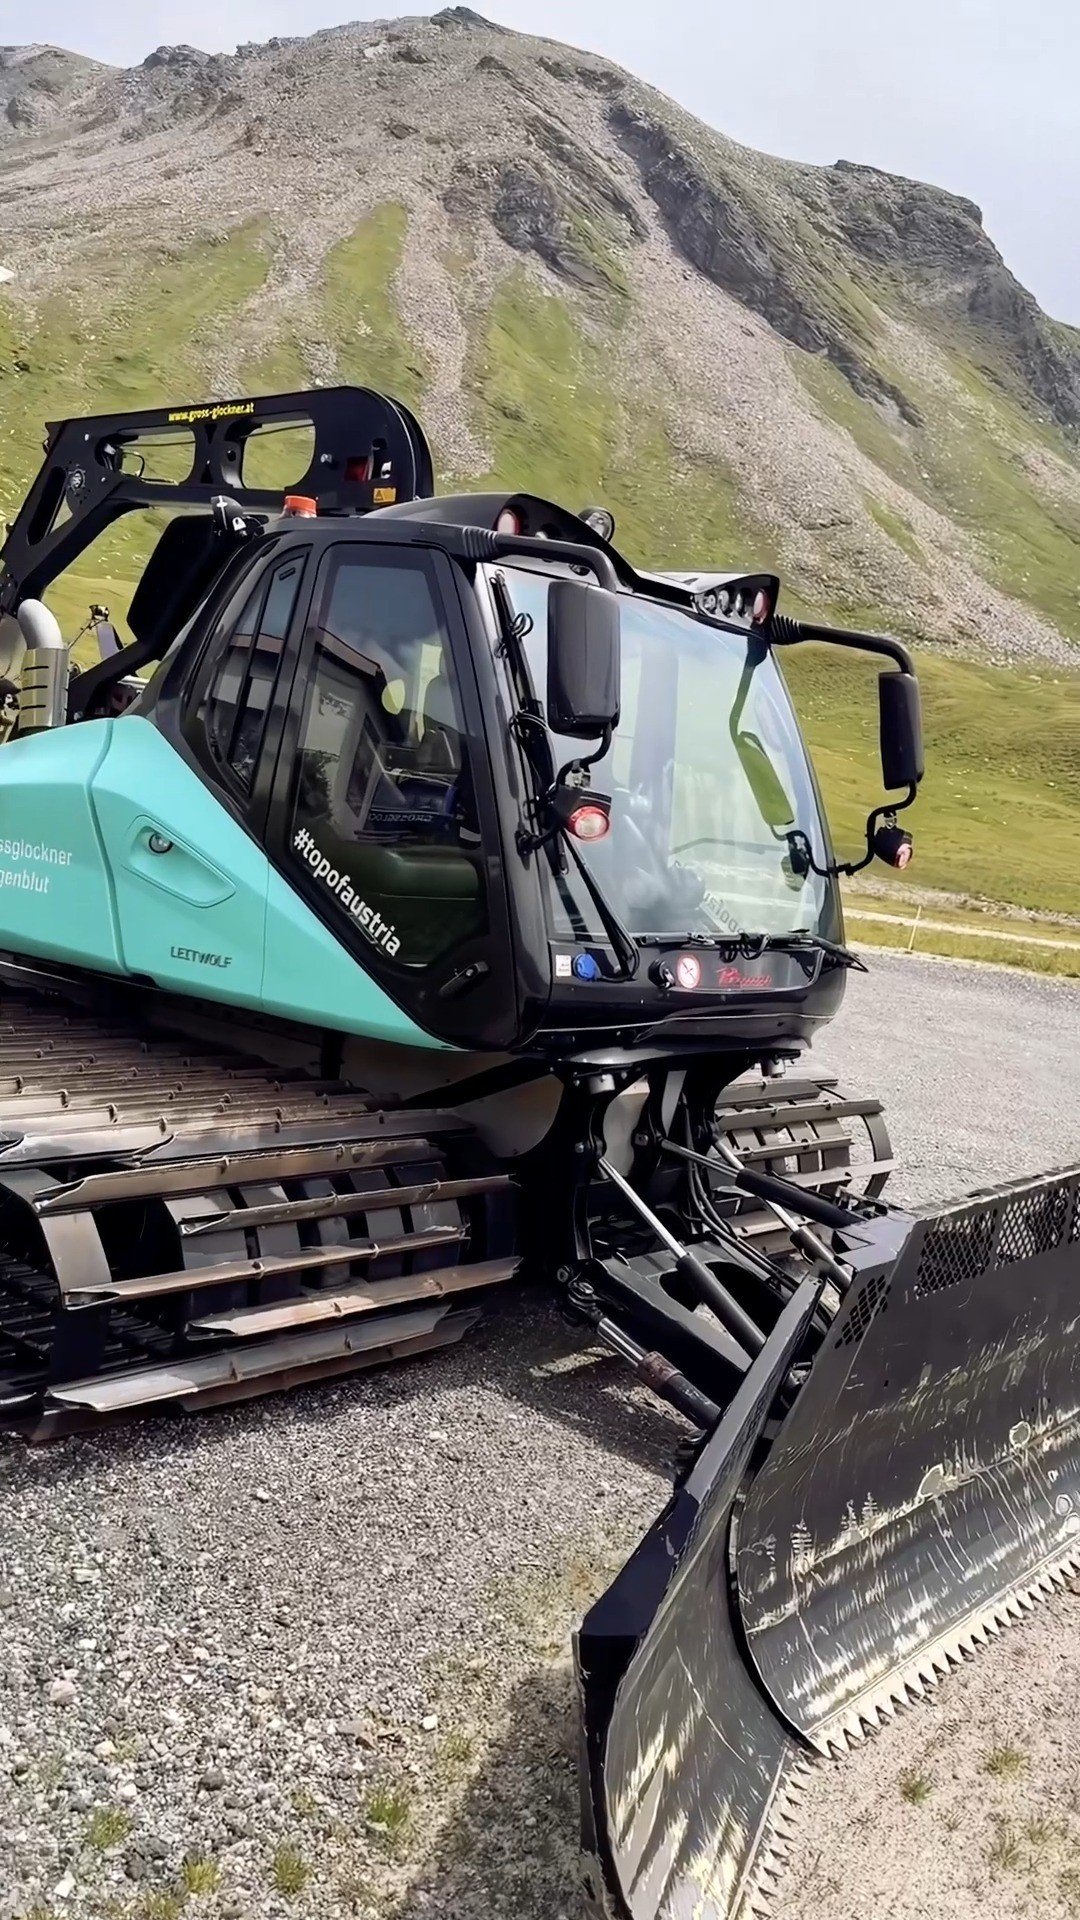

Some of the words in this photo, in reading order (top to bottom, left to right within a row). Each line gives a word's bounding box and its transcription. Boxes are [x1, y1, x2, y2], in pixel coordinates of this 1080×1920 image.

[168, 402, 254, 422] www.gross-glockner.at
[294, 828, 401, 956] #topofaustria
[170, 946, 232, 968] LEITWOLF
